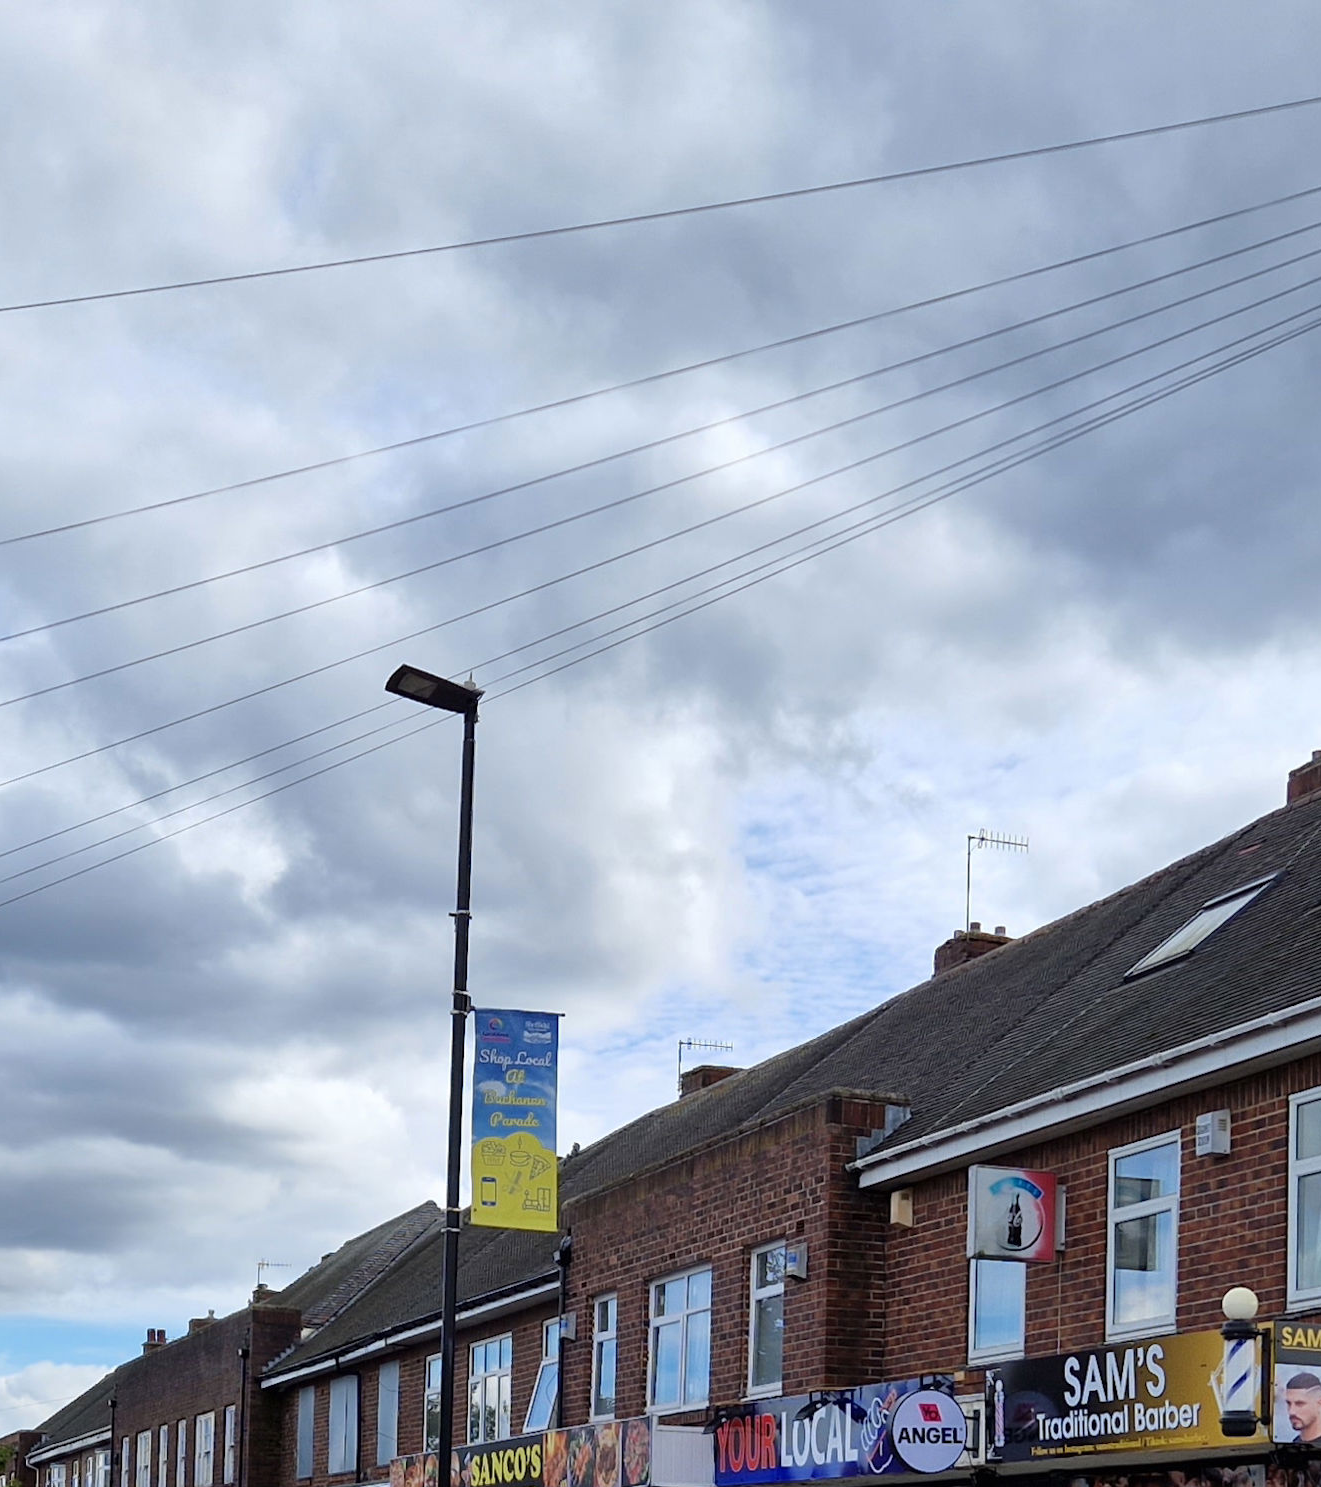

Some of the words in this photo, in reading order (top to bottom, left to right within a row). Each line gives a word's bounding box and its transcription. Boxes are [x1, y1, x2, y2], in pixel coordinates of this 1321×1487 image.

[479, 1048, 513, 1071] Shop
[514, 1051, 552, 1067] Local
[506, 1069, 525, 1084] At
[1063, 1344, 1166, 1407] SAM'S
[717, 1412, 777, 1473] YOUR
[780, 1401, 859, 1468] LOCAL
[897, 1427, 963, 1444] ANGEL
[1036, 1404, 1128, 1441] Traditional
[1134, 1399, 1201, 1432] Barber
[470, 1444, 542, 1487] SANCO'S
